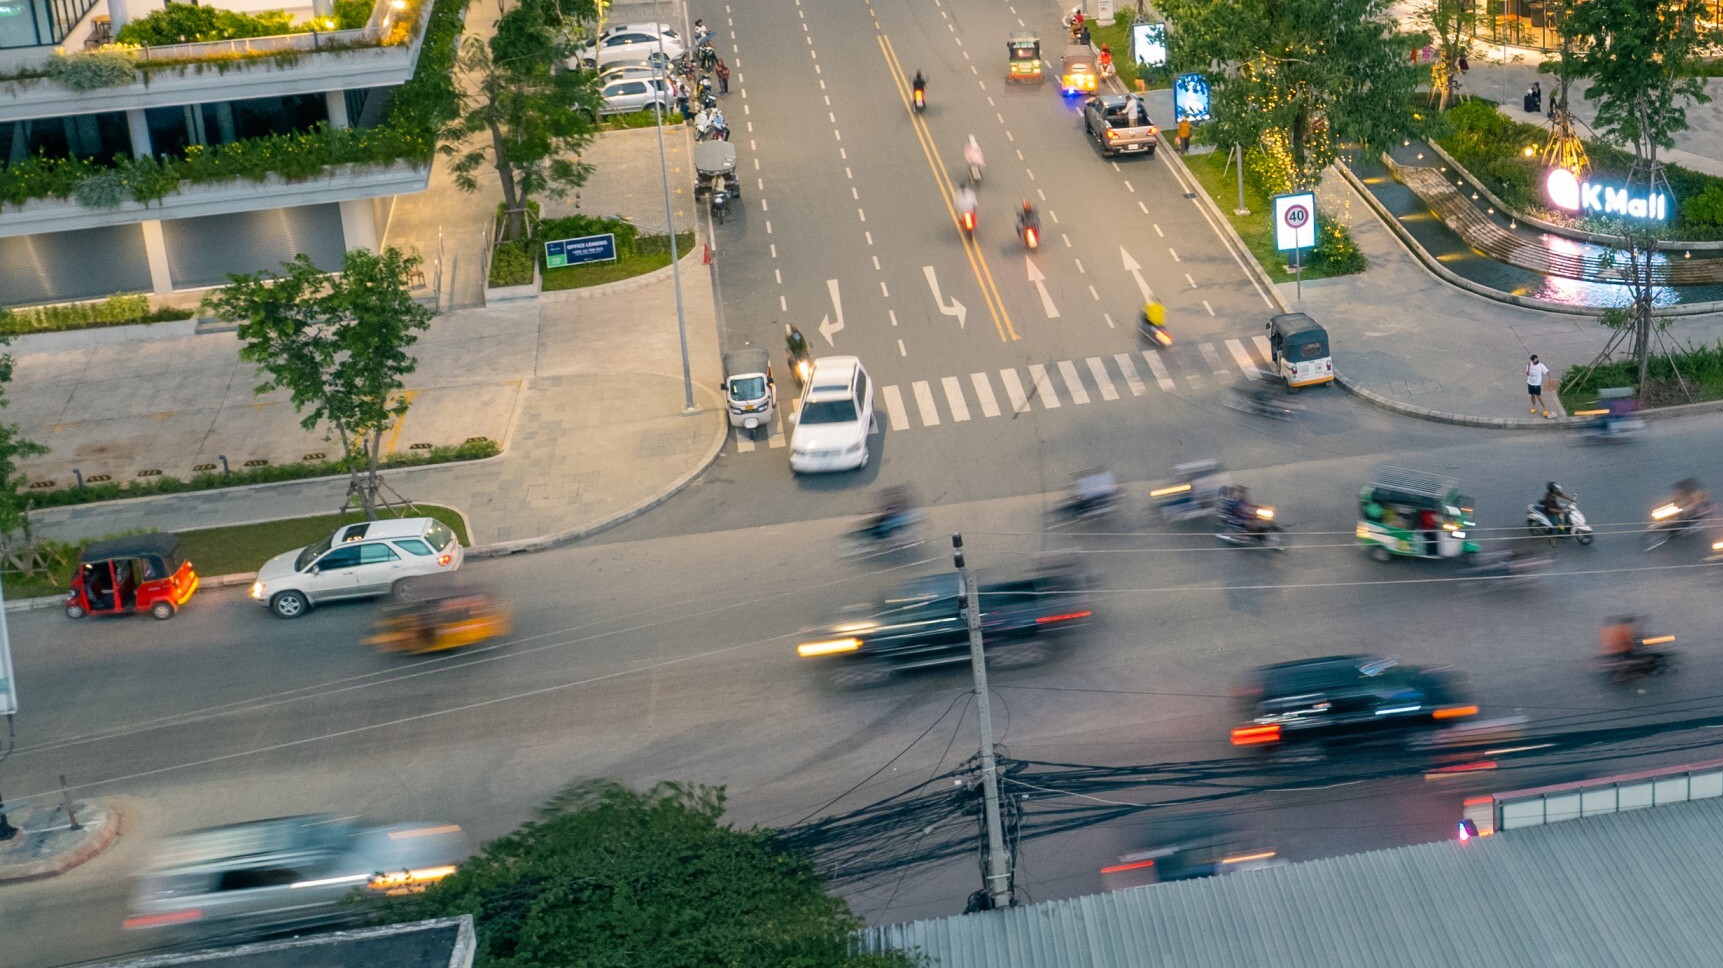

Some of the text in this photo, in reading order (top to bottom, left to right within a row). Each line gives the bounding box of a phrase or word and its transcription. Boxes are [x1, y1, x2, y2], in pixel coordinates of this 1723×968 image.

[1581, 182, 1665, 220] K Mall
[1289, 210, 1304, 222] 40
